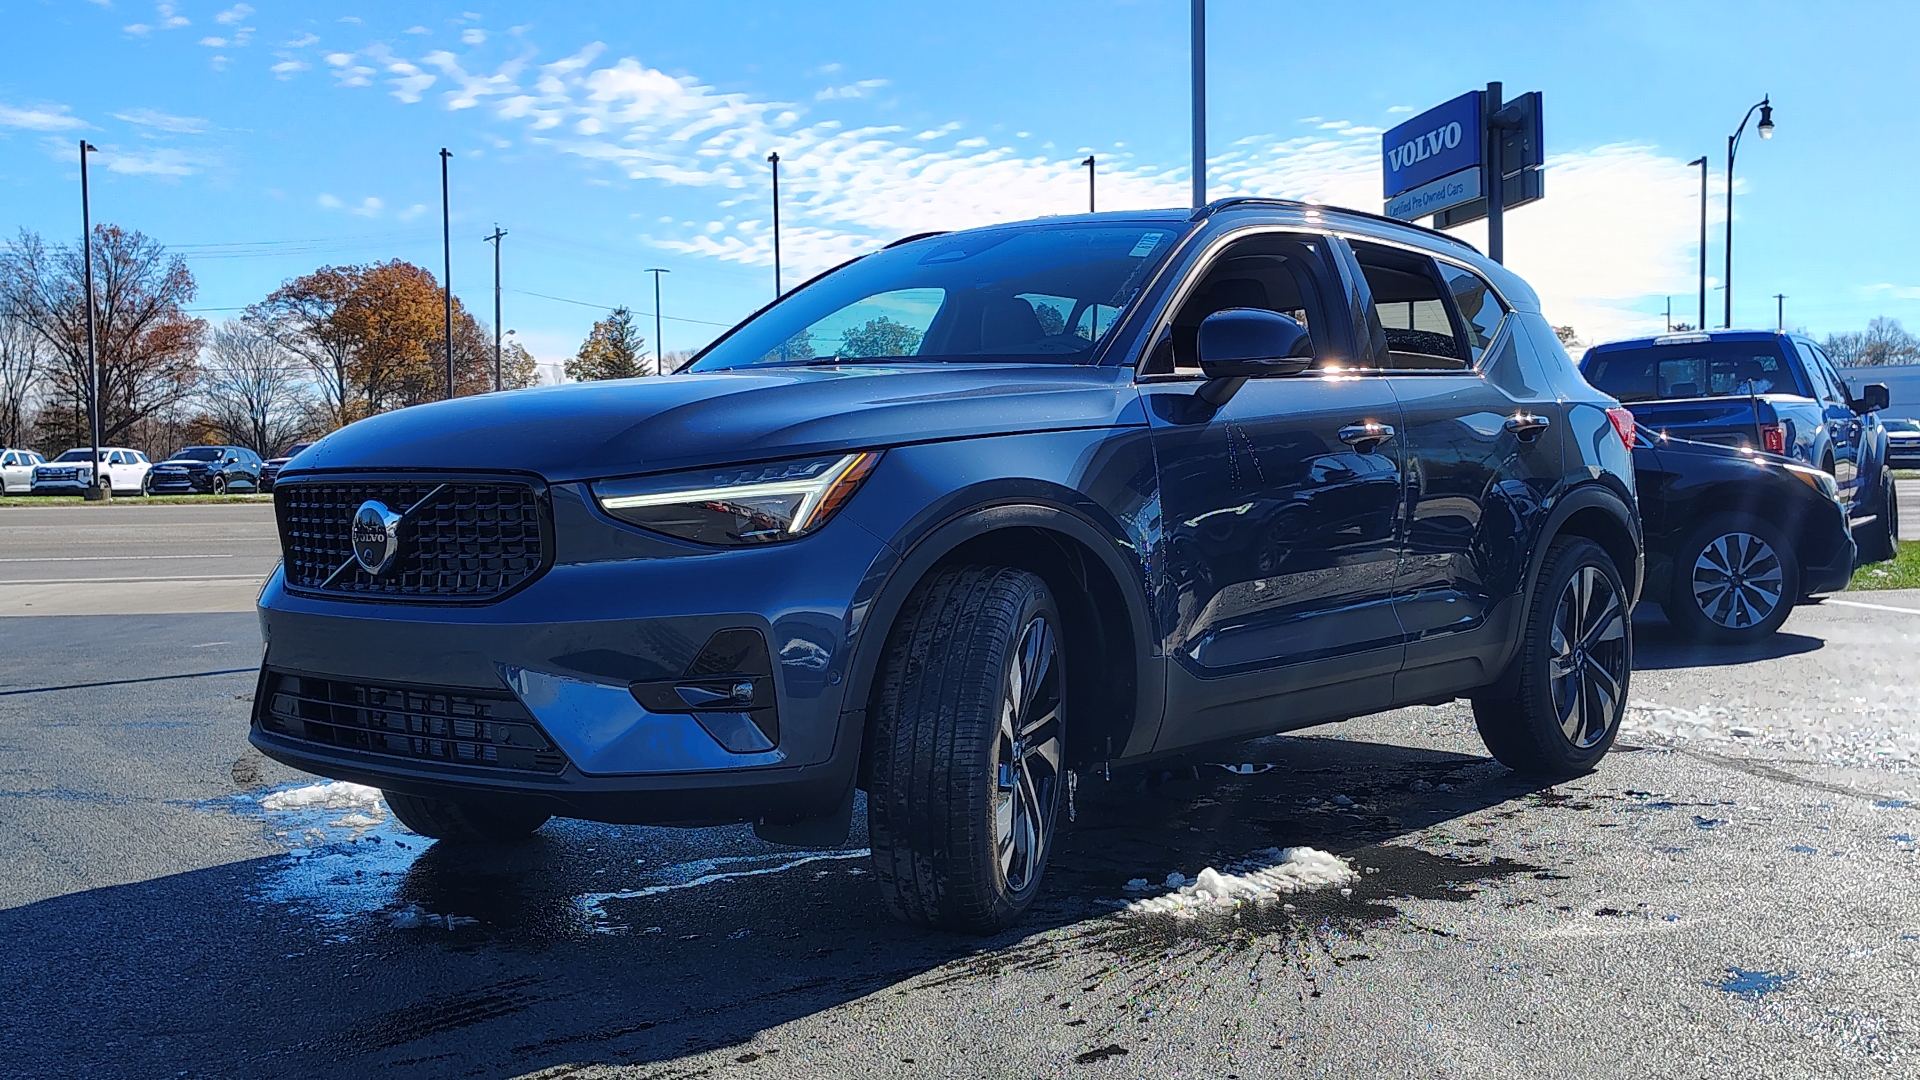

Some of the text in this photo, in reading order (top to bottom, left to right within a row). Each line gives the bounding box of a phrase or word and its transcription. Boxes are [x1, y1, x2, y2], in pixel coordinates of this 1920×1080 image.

[1388, 121, 1462, 173] VOLVO
[1389, 182, 1464, 217] Certified Pre Owned Cars
